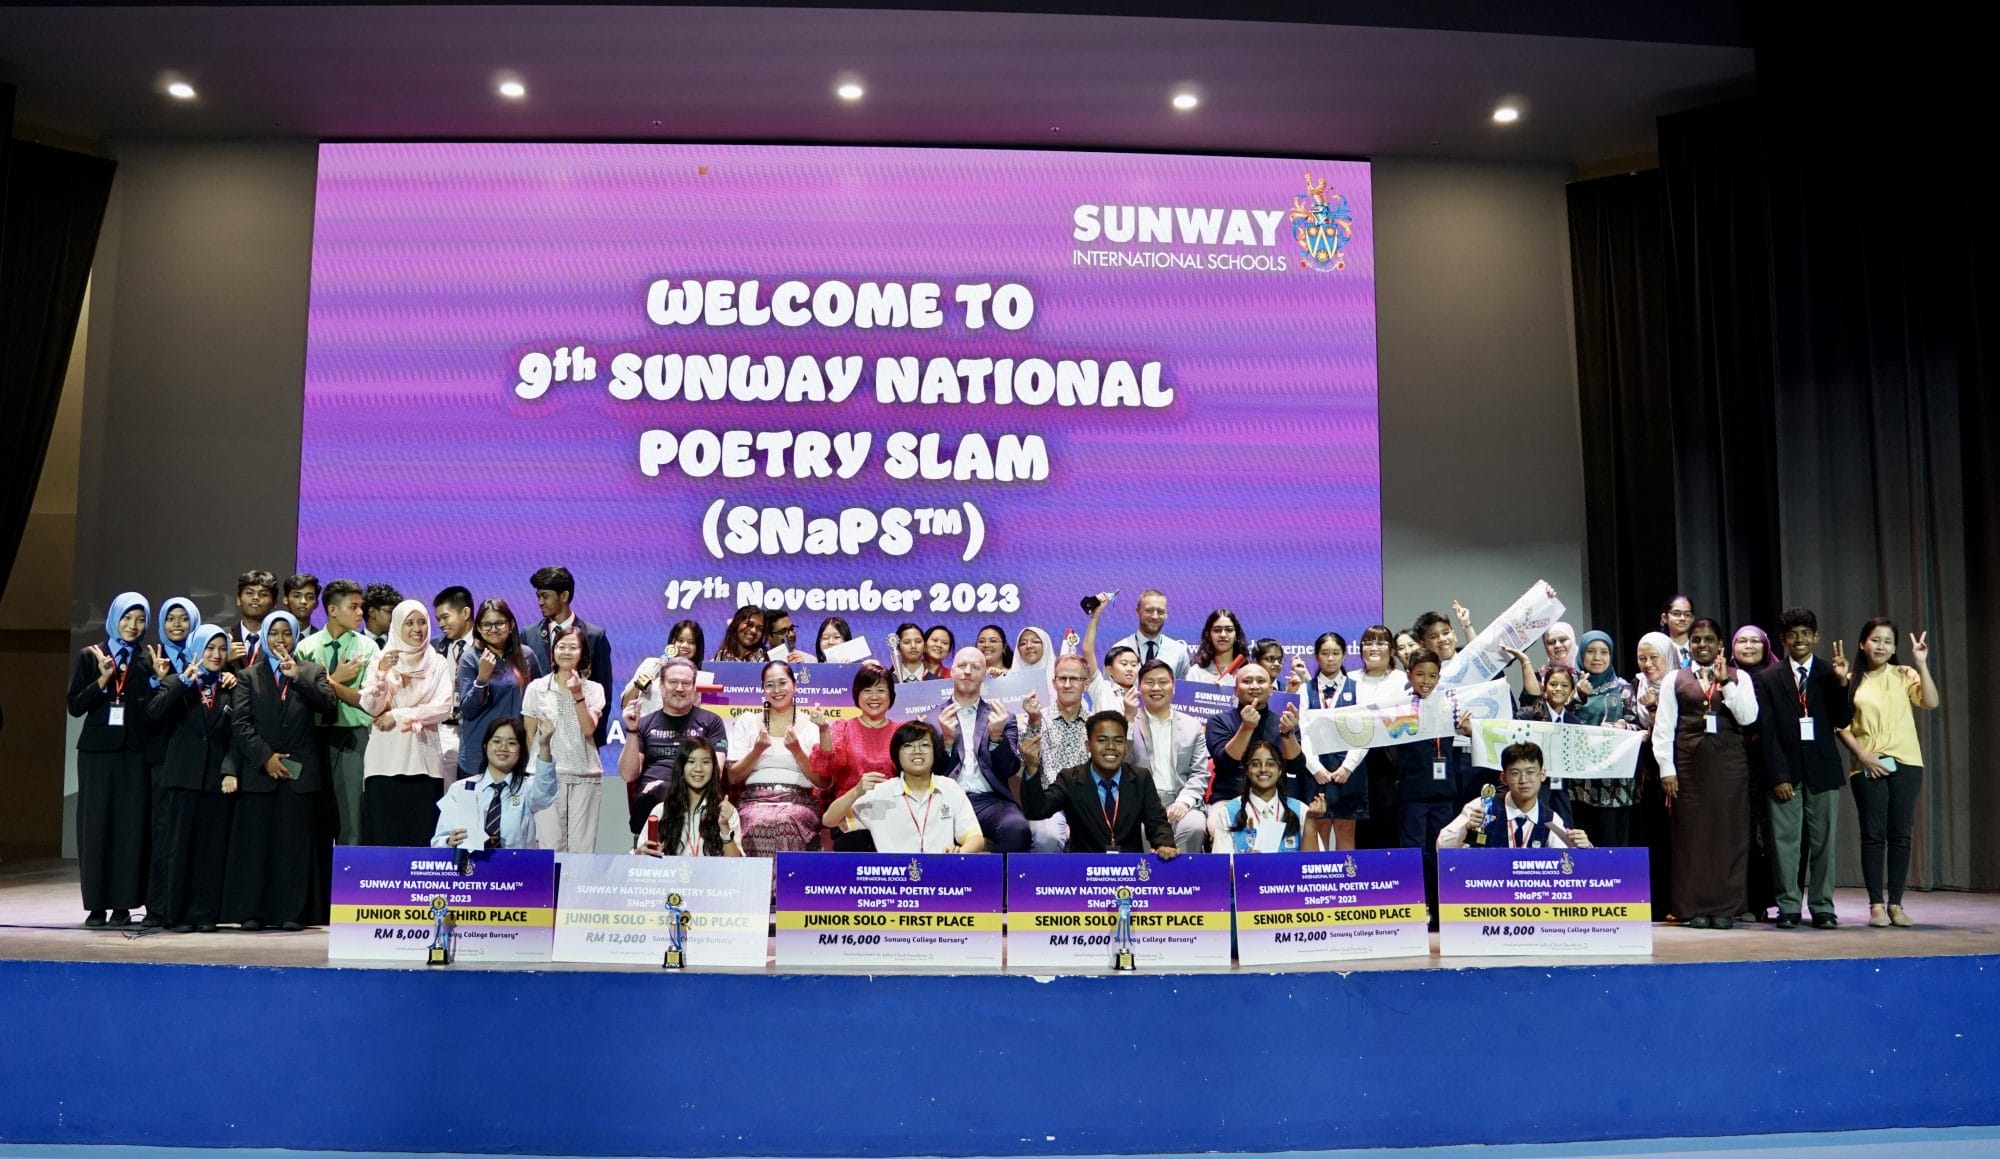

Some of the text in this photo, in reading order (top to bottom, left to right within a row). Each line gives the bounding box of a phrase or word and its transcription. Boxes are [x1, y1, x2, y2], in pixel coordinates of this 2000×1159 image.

[1073, 204, 1285, 246] SUNWAY
[1073, 250, 1286, 271] INTERNATIONAL SCHOOLS
[647, 279, 1034, 330] WELCOME TO
[515, 346, 1174, 408] 9th SUNWAY NATIONAL
[639, 429, 1049, 482] POETRY SLAM
[664, 576, 1021, 613] 17th November 2023
[723, 686, 754, 694] SUNWAY
[1194, 691, 1232, 703] SUNWAY
[1302, 864, 1343, 874] SUNWAY
[1513, 861, 1559, 869] SUNWAY
[628, 868, 677, 878] SUNWAY
[857, 867, 907, 876] SUNWAY
[1087, 867, 1136, 876] SUNWAY
[360, 880, 400, 888] SUNWAY
[404, 881, 450, 890] NATIONAL
[453, 882, 487, 890] POETRY
[1259, 884, 1295, 894] SUNWAY
[1297, 883, 1338, 893] NATIONAL
[1340, 882, 1368, 891] POETRY
[577, 886, 617, 894] SUNWAY
[620, 887, 665, 895] NATIONAL
[805, 886, 847, 894] SUNWAY
[850, 886, 897, 895] NATIONAL
[900, 887, 935, 895] POETRY
[1036, 886, 1077, 895] SUNWAY
[1080, 886, 1120, 895] NATION
[449, 894, 472, 903] 2023
[1552, 892, 1572, 900] 2023
[897, 900, 919, 908] 2023
[1087, 900, 1148, 908] SNaPS 023
[356, 909, 527, 921] JUNIOR SOLO THIRD PLACE
[1254, 912, 1293, 925] SENIOR
[1297, 912, 1324, 922] SOLO
[1335, 909, 1377, 921] SECOND
[1380, 908, 1411, 918] PLACE
[1464, 907, 1506, 917] SENIOR
[1511, 907, 1540, 917] SOLO
[1552, 907, 1588, 917] THIRD
[1592, 907, 1627, 916] PLACE
[565, 913, 611, 925] JUNIOR
[614, 914, 645, 925] SOLO
[658, 915, 707, 926] SEND
[712, 917, 749, 927] PLACE
[804, 915, 849, 927] JUNIOR
[854, 915, 886, 925] SOLO
[900, 916, 933, 926] FIRST
[937, 916, 974, 926] PLACE
[1036, 916, 1203, 926] SENIOR SOLO FIRST PLACE
[374, 929, 393, 939] RM
[397, 929, 429, 940] 8,000
[1482, 926, 1500, 936] RM
[1503, 926, 1535, 936] 8,000
[586, 932, 605, 943] RM
[609, 933, 646, 944] 12,000
[819, 934, 837, 944] RM
[842, 935, 880, 945] 16,000
[1050, 935, 1068, 945] RM
[1072, 935, 1110, 946] 16,000
[1275, 932, 1291, 943] RM
[1294, 931, 1326, 943] 12,000
[1330, 931, 1352, 939] Sunway
[1354, 930, 1374, 938] College
